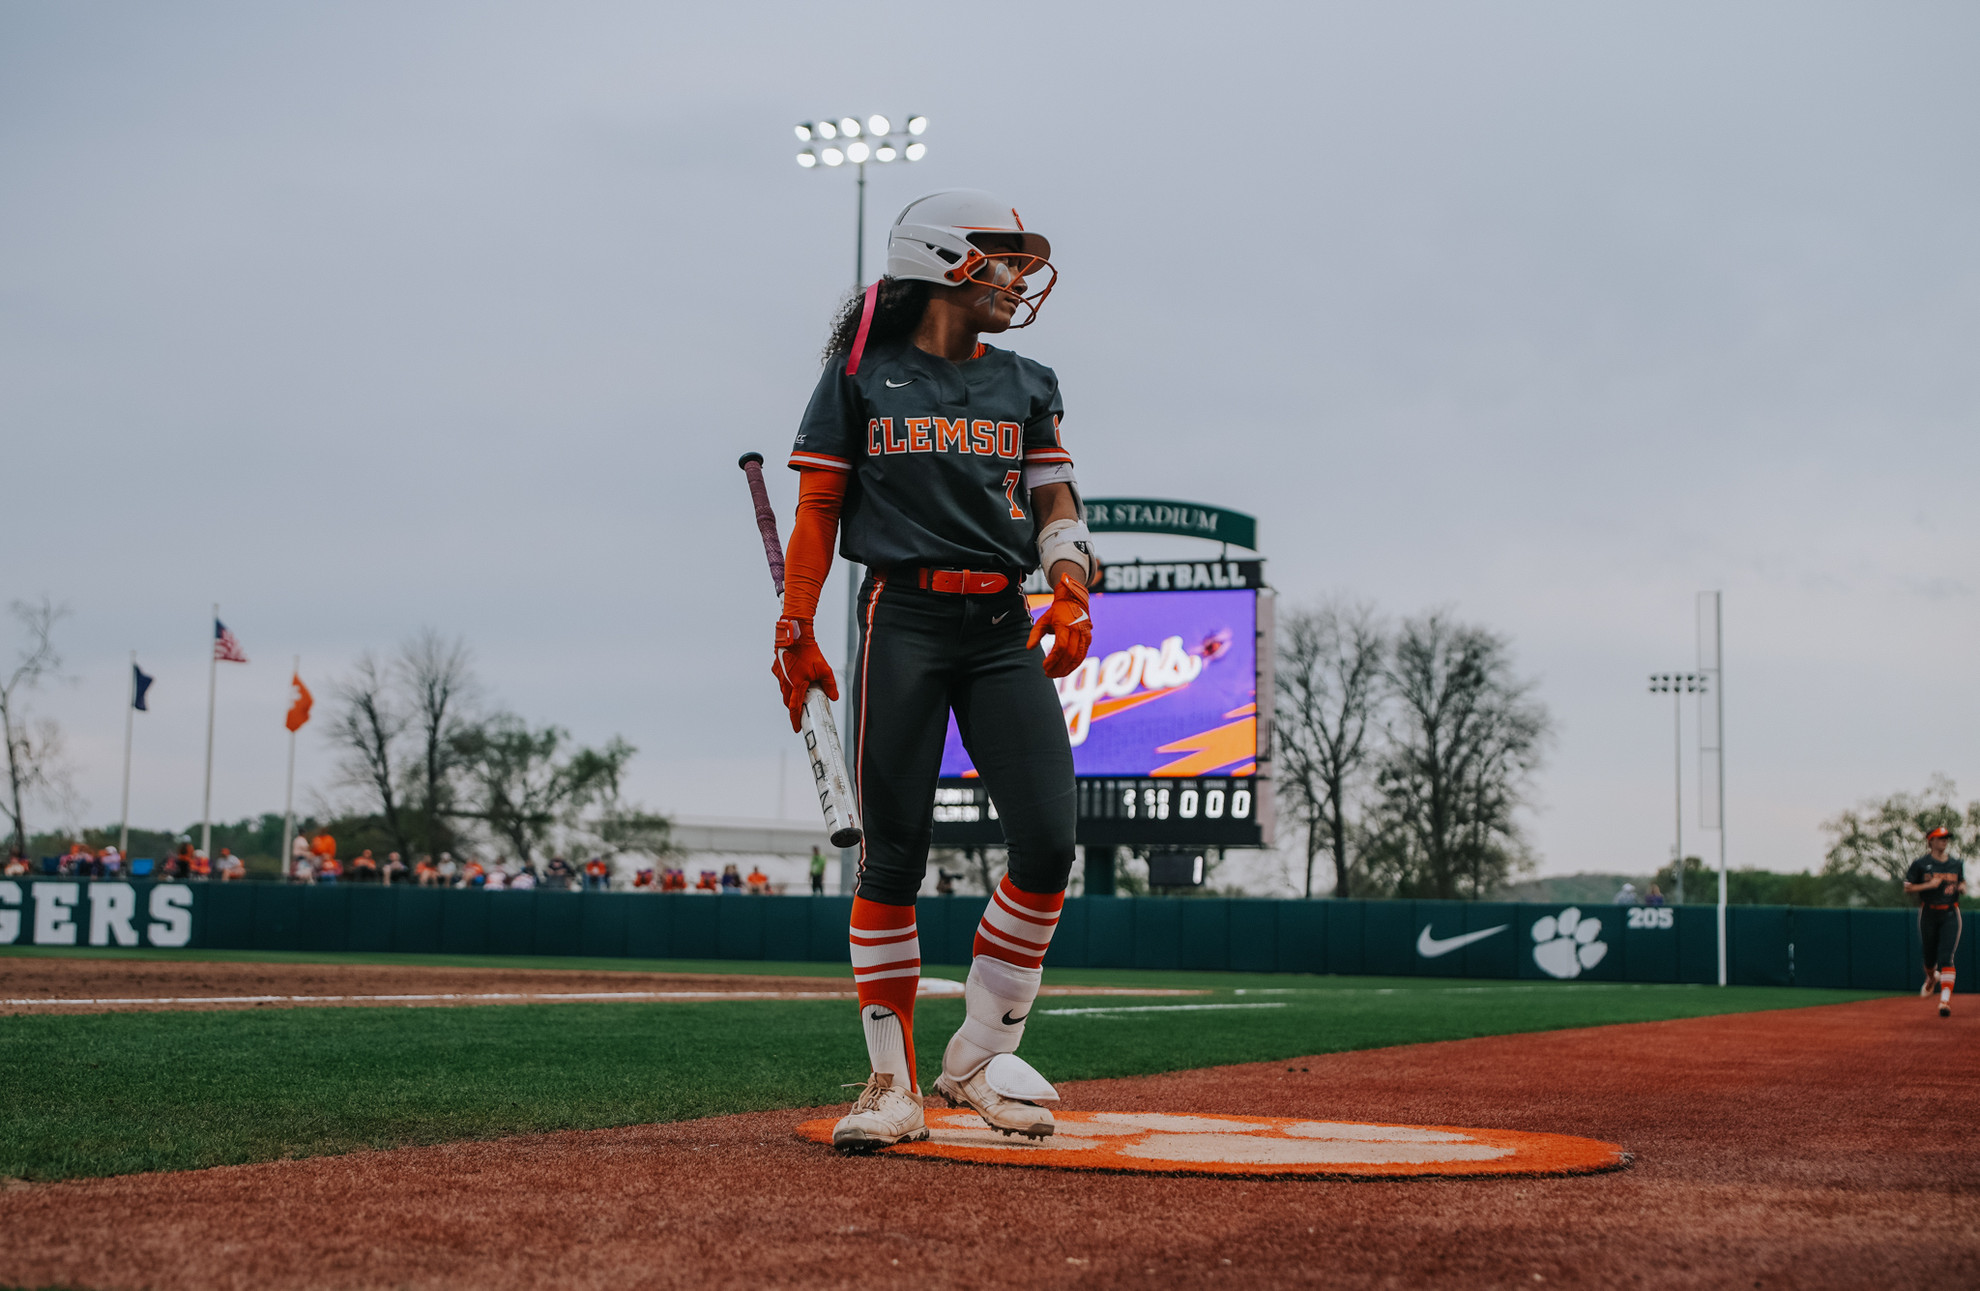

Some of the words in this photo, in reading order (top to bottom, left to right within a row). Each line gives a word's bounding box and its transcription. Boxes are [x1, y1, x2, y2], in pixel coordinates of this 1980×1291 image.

[868, 416, 1024, 460] CLEMSO
[1002, 469, 1026, 520] 7
[1112, 504, 1218, 532] STADIUM
[1104, 562, 1246, 591] SOFTBALL
[1040, 633, 1202, 748] gers
[1179, 790, 1199, 819] 0
[1205, 790, 1225, 819] 0
[1231, 790, 1251, 819] 0
[1627, 907, 1674, 929] 205
